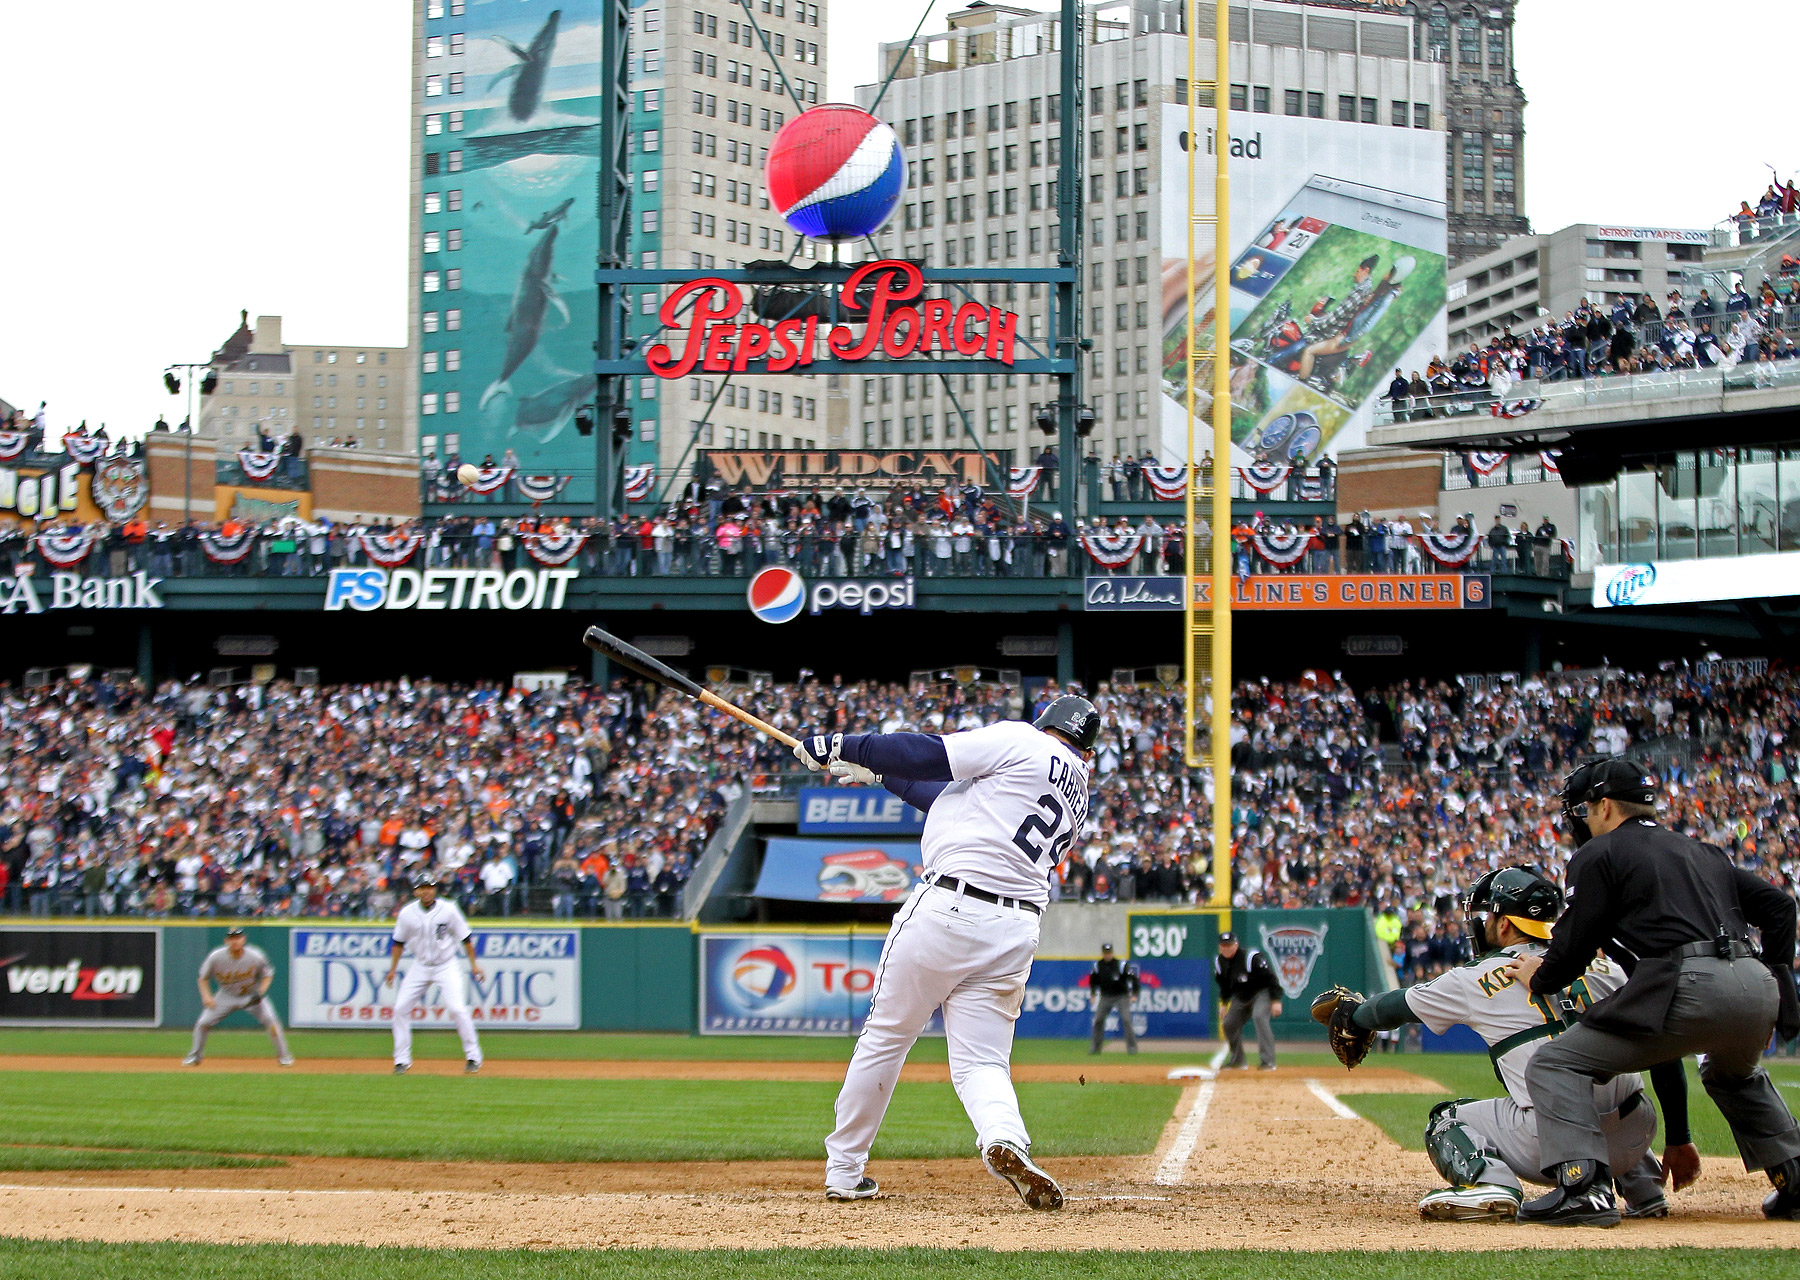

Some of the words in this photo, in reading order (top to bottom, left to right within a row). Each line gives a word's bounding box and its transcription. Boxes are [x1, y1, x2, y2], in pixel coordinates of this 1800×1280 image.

[1207, 127, 1262, 160] iad
[1599, 227, 1708, 241] DETROITCITYAPTS.COM
[646, 277, 818, 379] PEPSI
[827, 259, 1017, 366] PORCH
[707, 452, 1000, 487] WILDCAT
[781, 478, 947, 488] BLEACHERS
[50, 570, 165, 609] Bank
[811, 577, 916, 616] pepsi
[1193, 582, 1329, 603] KLINE'S
[1340, 581, 1455, 603] CORNER
[1466, 581, 1485, 603] 6
[805, 797, 904, 823] BELLE
[304, 935, 389, 957] BACK!
[483, 935, 570, 958] BACK!
[7, 957, 144, 1000] verizon
[318, 960, 557, 1007] DYMIC
[410, 1006, 542, 1021] DYAMIC
